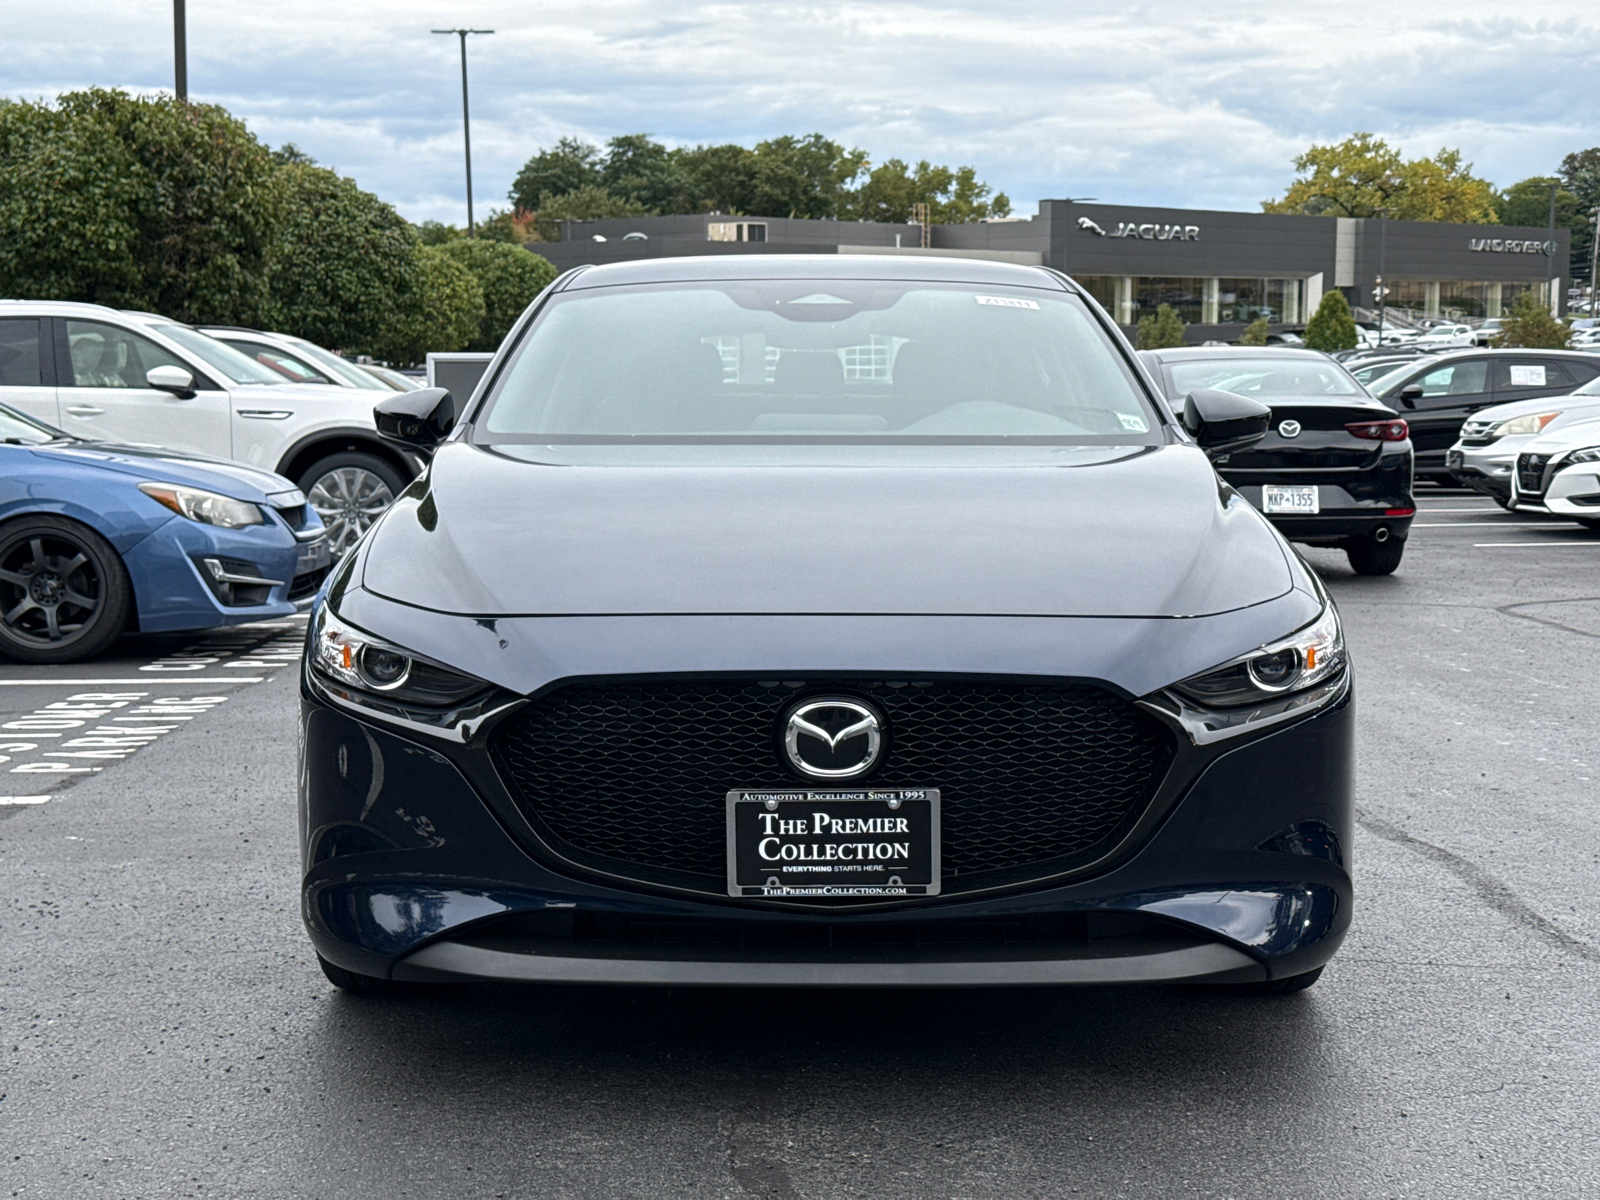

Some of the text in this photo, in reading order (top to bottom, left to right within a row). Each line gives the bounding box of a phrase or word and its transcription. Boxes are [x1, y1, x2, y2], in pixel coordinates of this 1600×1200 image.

[1108, 222, 1200, 241] JAGUAR
[1469, 238, 1541, 253] LAND ROVER
[9, 696, 229, 773] PARKING
[742, 791, 925, 801] AUTOMOTIVE EXCELLENCE SINCE 1995
[758, 812, 910, 835] THE PREMIER
[758, 837, 910, 861] COLLECTION
[782, 865, 832, 873] EVERYTHING
[761, 886, 907, 896] THEPREMIERCOLLECTION.COM
